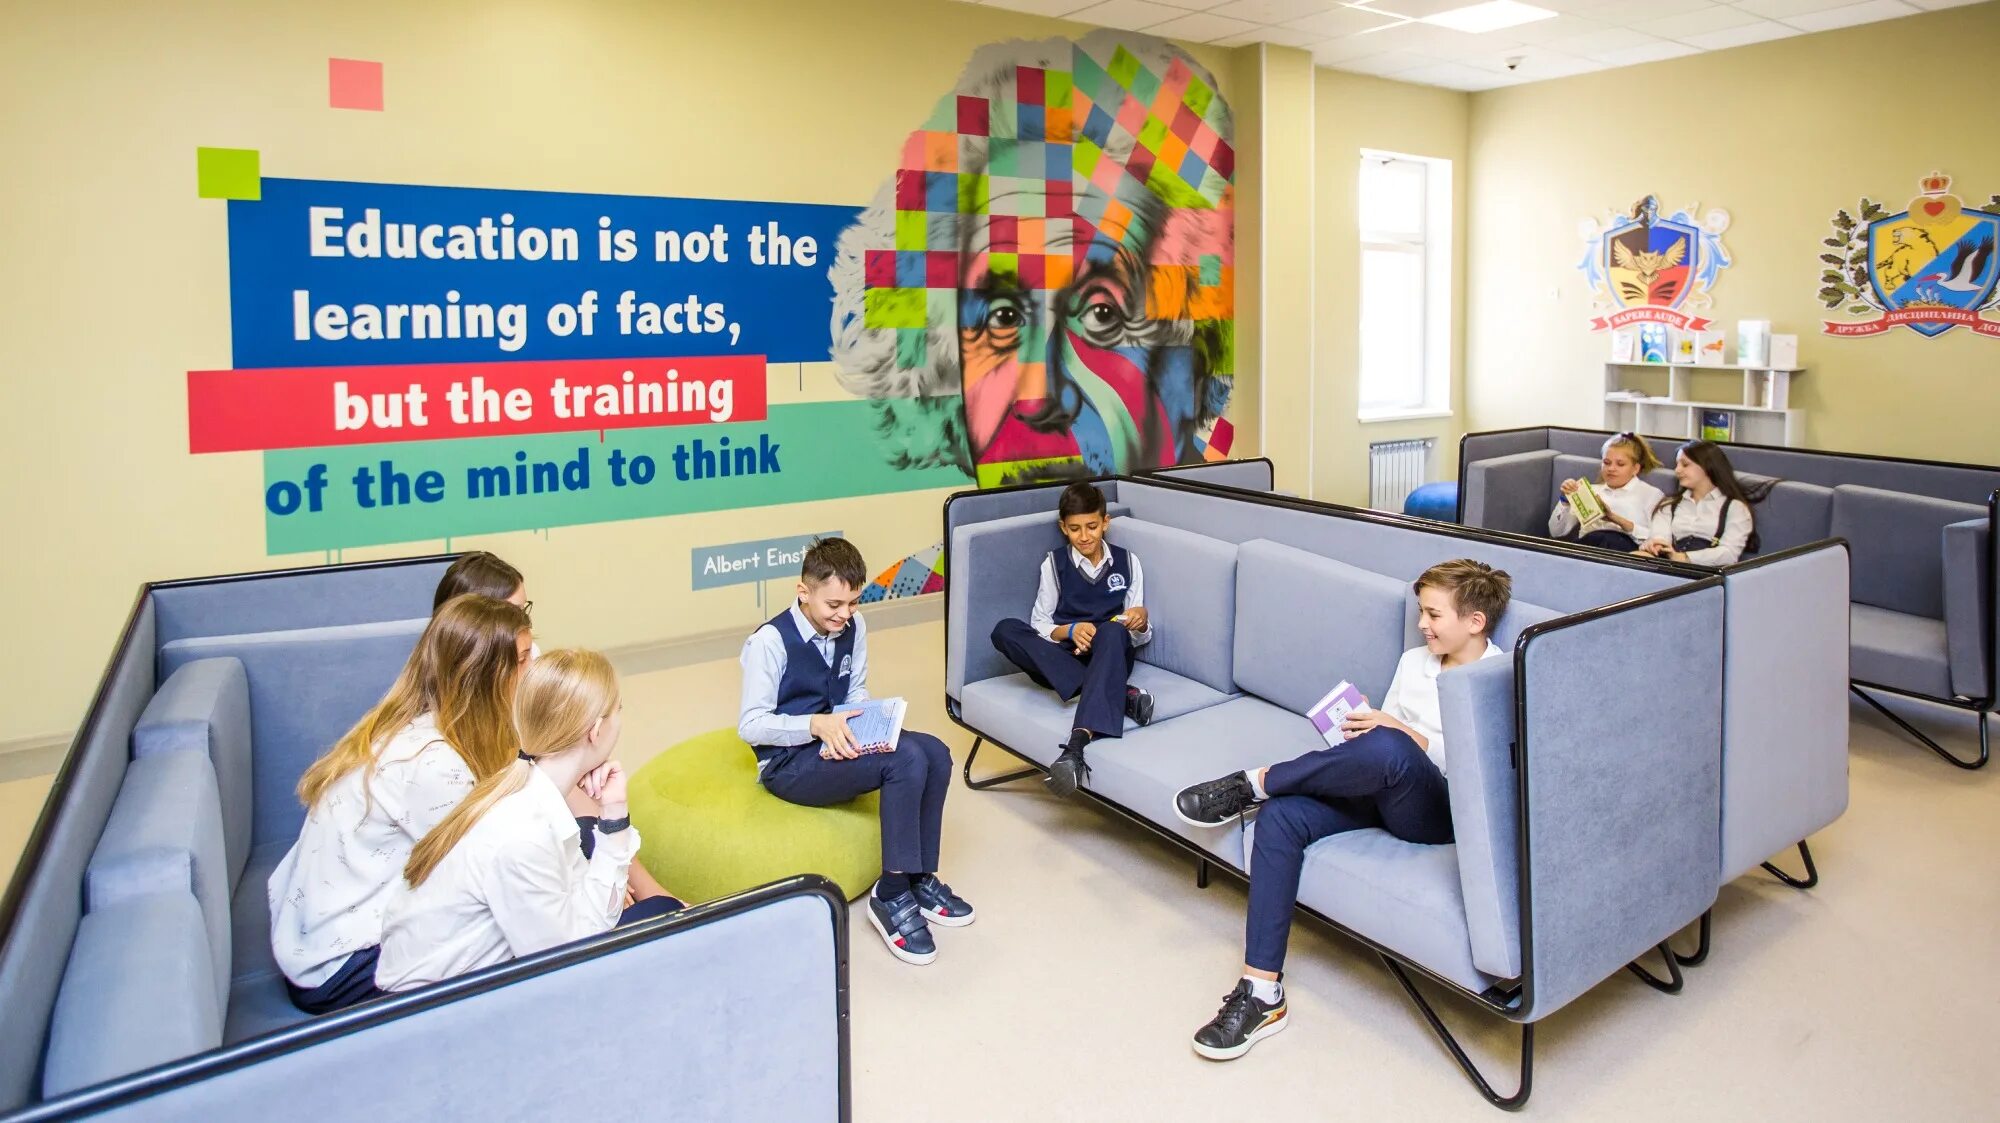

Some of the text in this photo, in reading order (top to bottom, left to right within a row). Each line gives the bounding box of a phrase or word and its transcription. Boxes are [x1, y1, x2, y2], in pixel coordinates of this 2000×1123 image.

[309, 206, 818, 267] Education is not the
[293, 289, 741, 352] learning of facts,
[1613, 311, 1684, 325] SAPERE AUDE
[1834, 323, 1879, 334] ДРУЖБА
[1886, 310, 1976, 323] ДИСЦИПЛИНА
[333, 368, 734, 431] but the training
[265, 433, 781, 516] of the mind to think
[703, 545, 809, 576] Albert Einst
